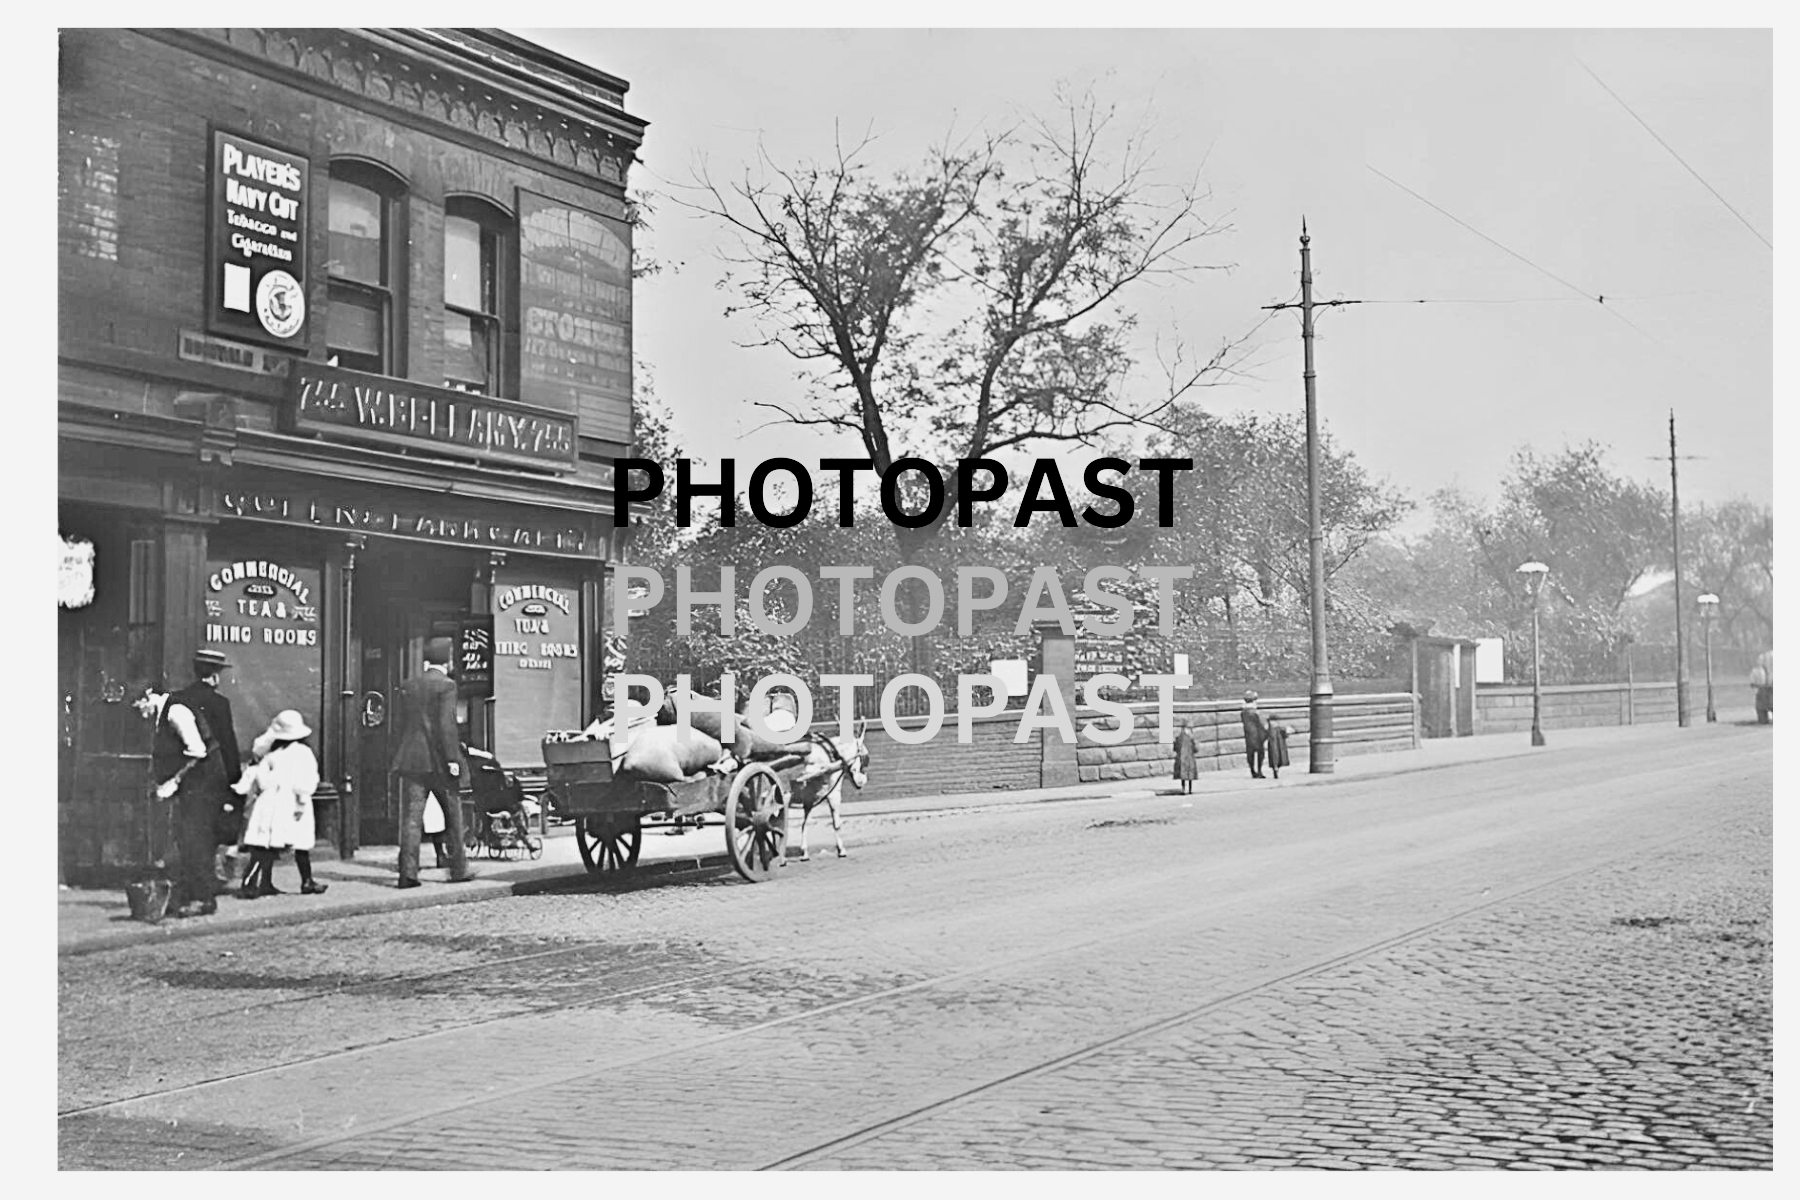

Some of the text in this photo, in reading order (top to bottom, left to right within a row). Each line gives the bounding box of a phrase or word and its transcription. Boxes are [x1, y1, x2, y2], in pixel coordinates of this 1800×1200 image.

[222, 142, 301, 191] PLAYER'S
[226, 178, 299, 220] NAVY CUT
[237, 598, 272, 618] TEA
[206, 623, 251, 643] INING
